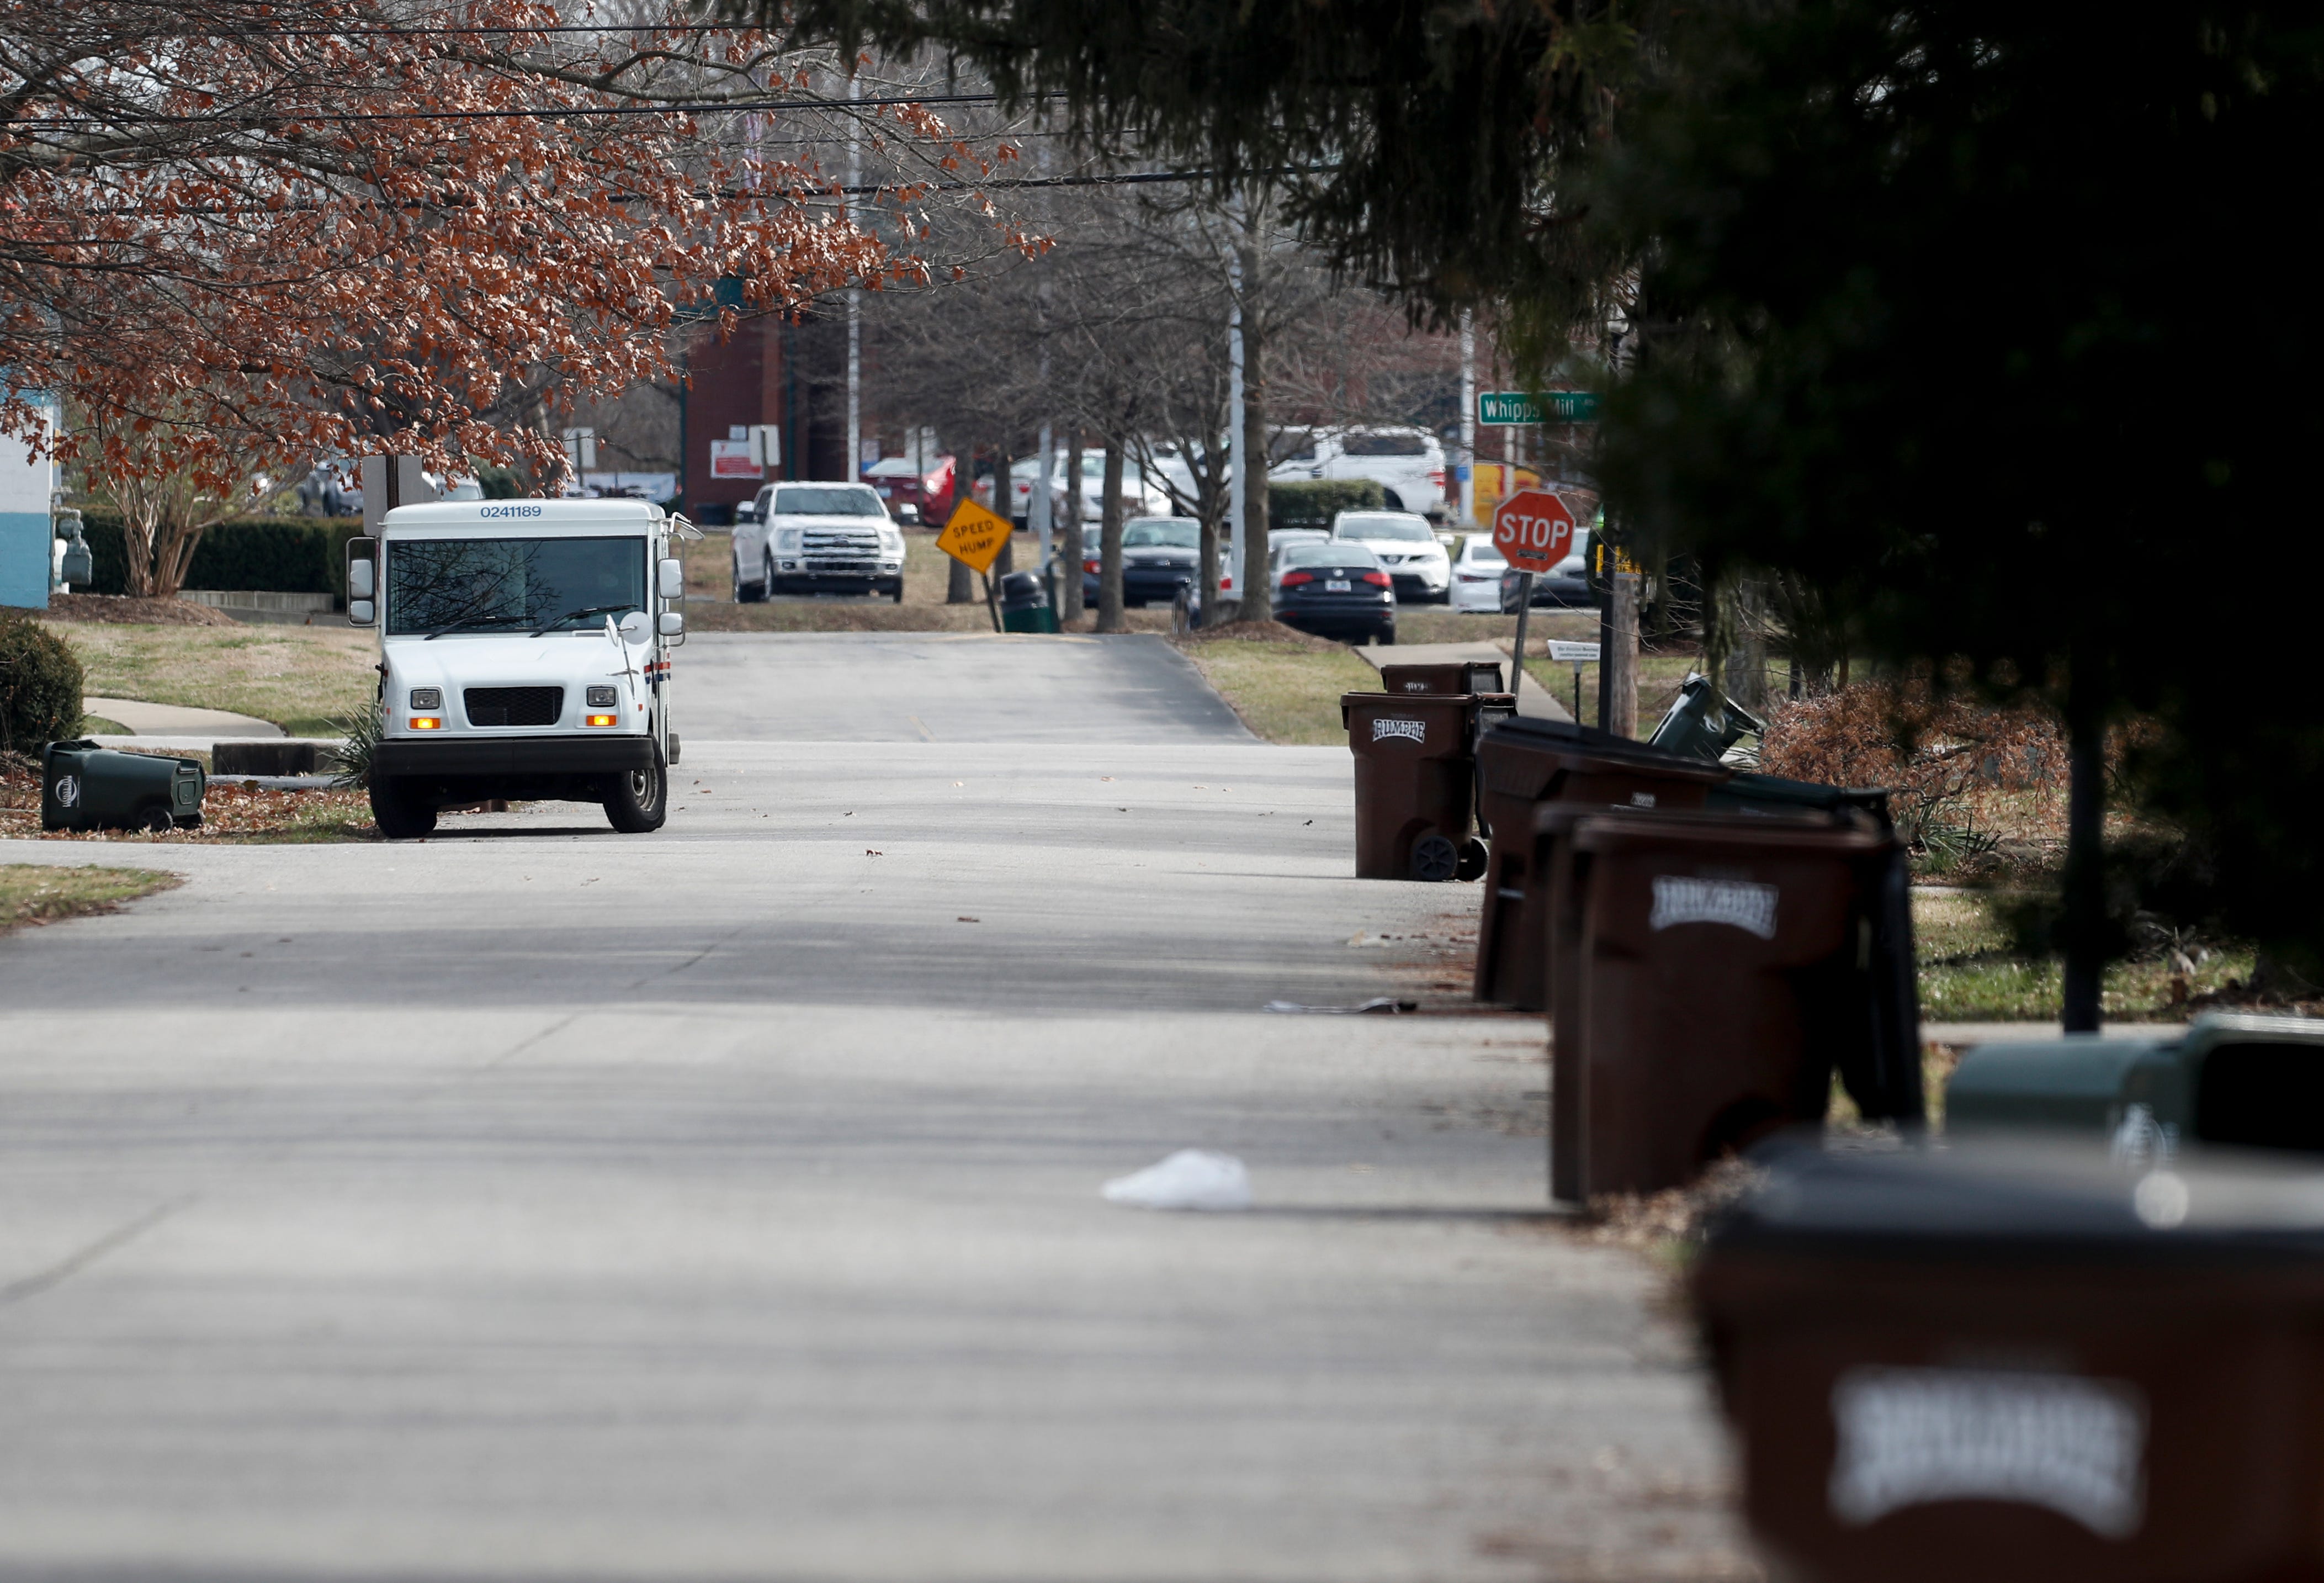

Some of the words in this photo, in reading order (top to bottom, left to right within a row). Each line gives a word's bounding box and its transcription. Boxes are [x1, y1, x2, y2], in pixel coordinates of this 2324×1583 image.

[1485, 399, 1540, 422] Whipps
[480, 506, 541, 518] 0241189
[953, 520, 993, 538] SPEED
[1499, 512, 1569, 549] STOP
[959, 538, 994, 554] HUMP
